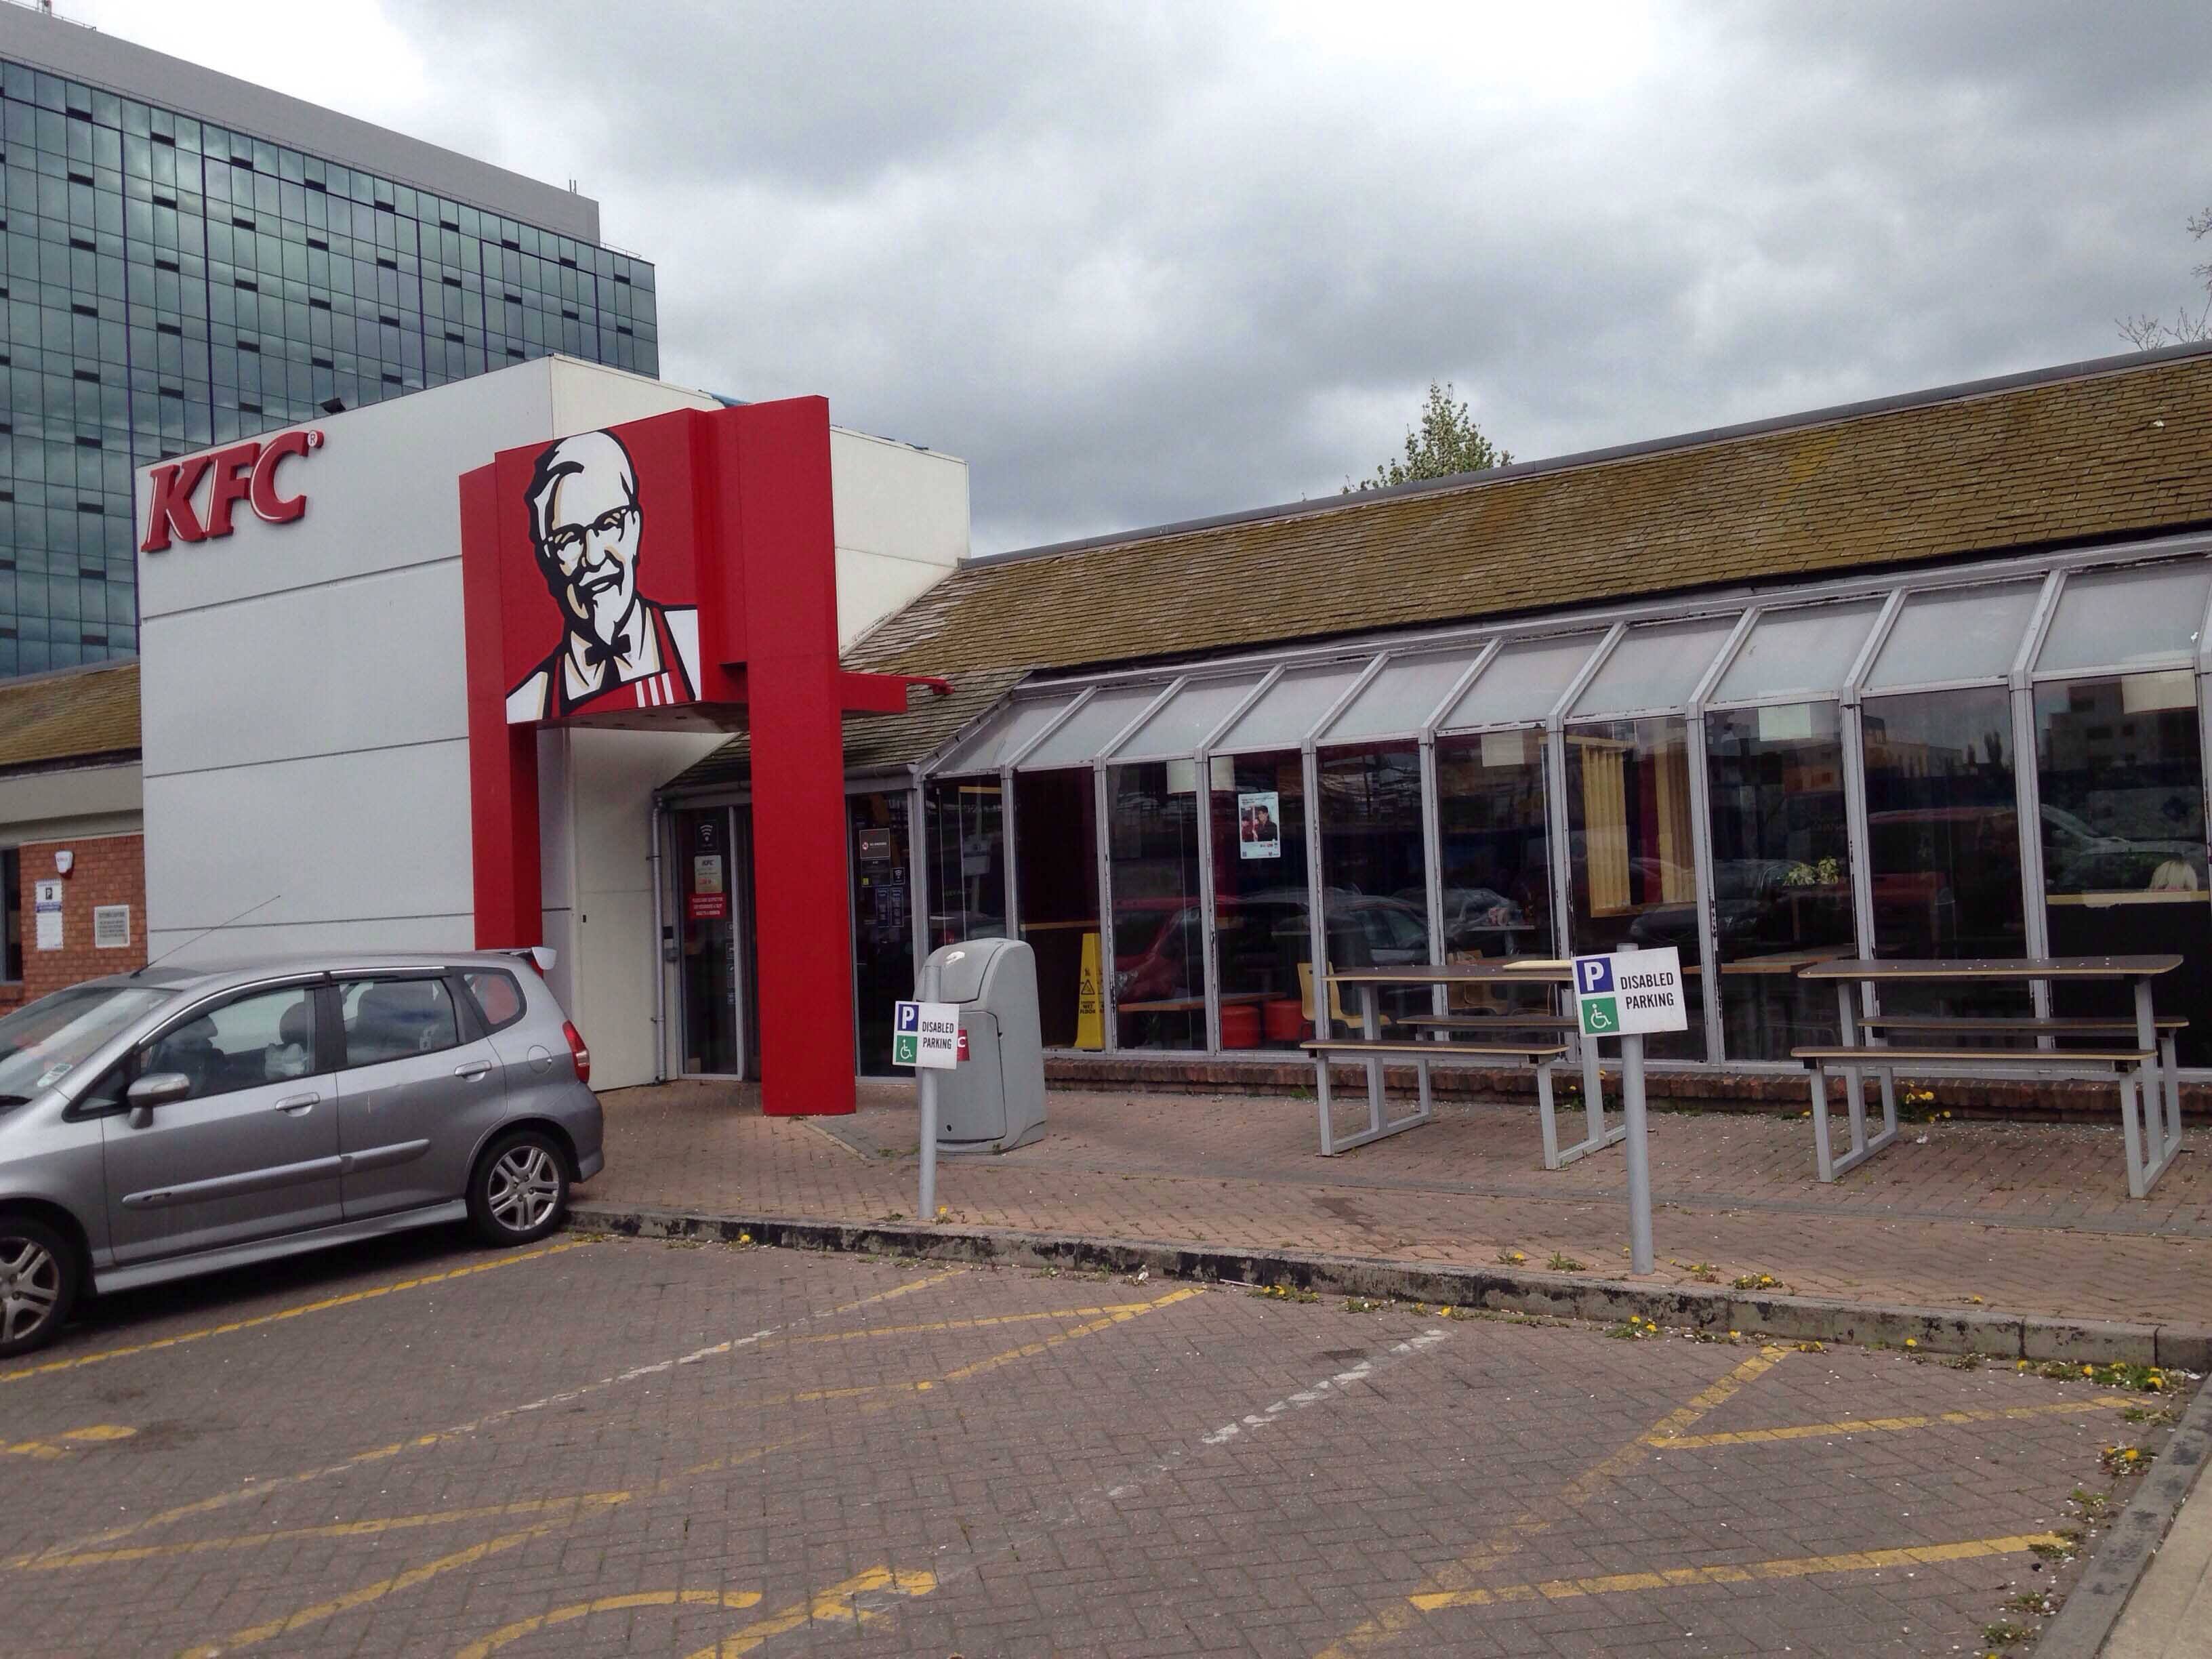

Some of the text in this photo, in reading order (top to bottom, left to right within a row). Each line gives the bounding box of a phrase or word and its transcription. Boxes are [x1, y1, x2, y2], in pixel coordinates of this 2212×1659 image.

[141, 430, 310, 552] KFC
[1584, 962, 1604, 991] P
[1620, 972, 1674, 990] DISABLED
[1625, 992, 1675, 1010] PARKING
[902, 1006, 915, 1029] P
[922, 1021, 954, 1034] DISABLED
[922, 1037, 952, 1050] PARKING
